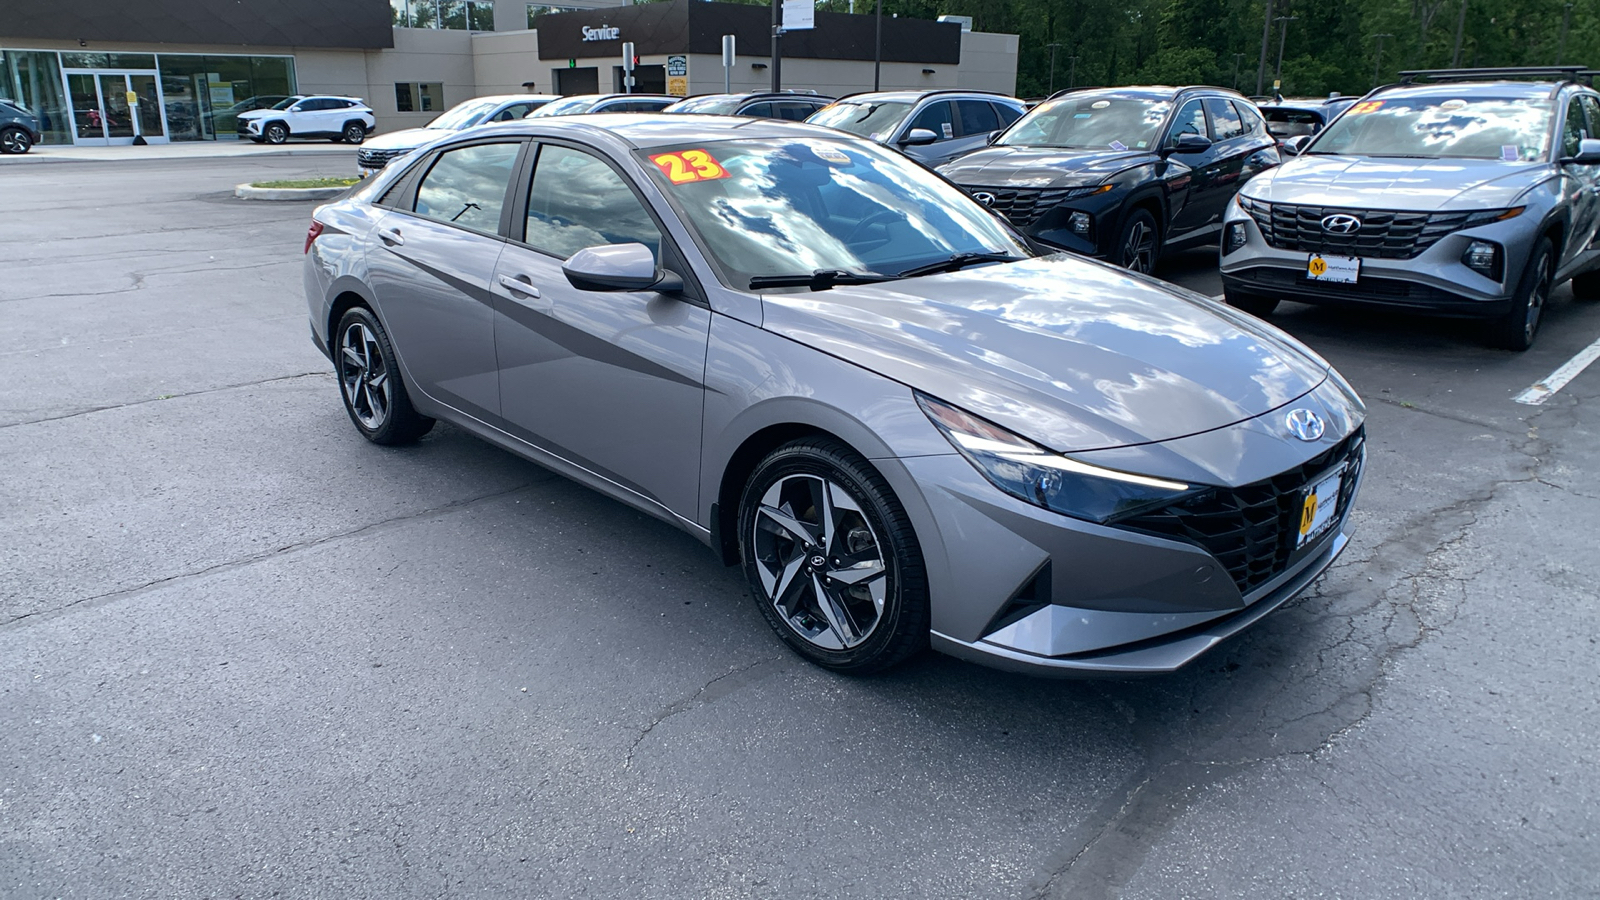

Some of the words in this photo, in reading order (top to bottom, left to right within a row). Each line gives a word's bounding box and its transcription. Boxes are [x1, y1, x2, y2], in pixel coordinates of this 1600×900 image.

[582, 24, 620, 41] Service
[655, 150, 723, 182] 23
[1312, 262, 1324, 271] M
[1302, 502, 1316, 527] M
